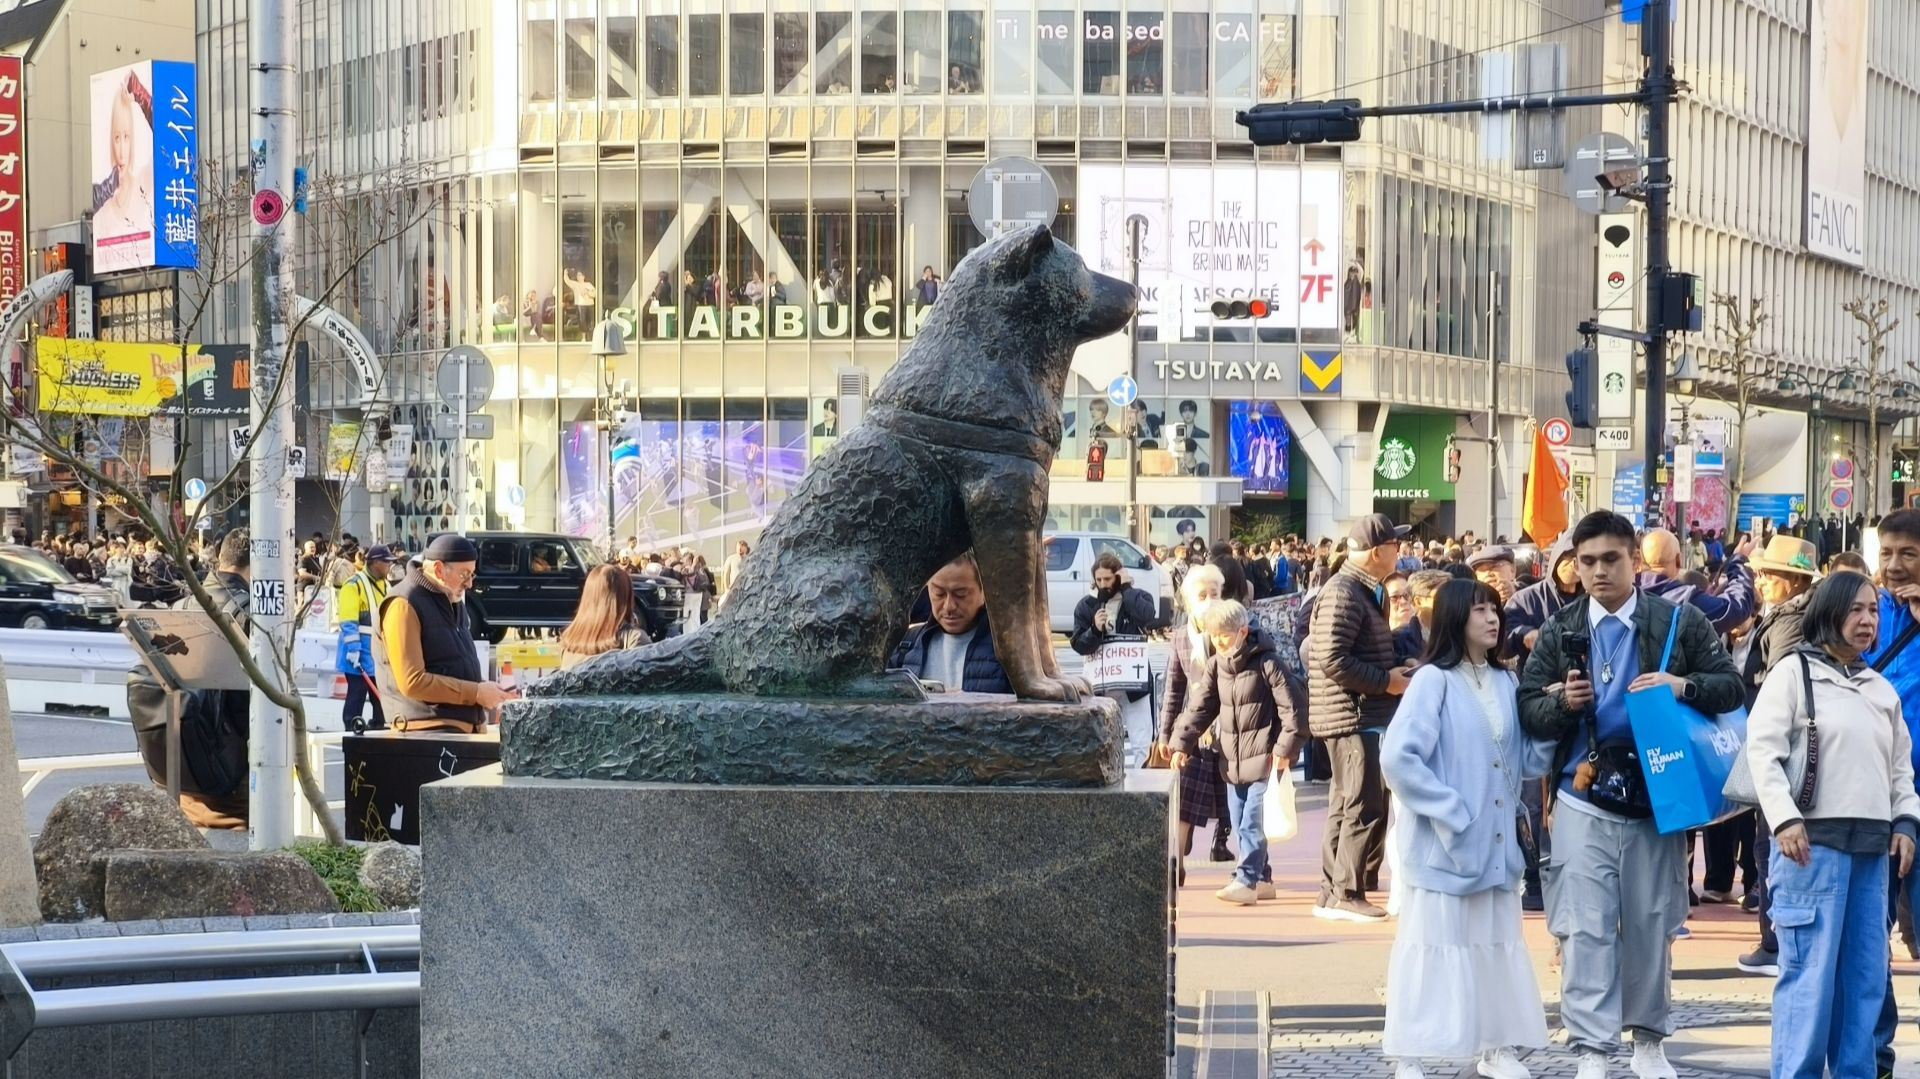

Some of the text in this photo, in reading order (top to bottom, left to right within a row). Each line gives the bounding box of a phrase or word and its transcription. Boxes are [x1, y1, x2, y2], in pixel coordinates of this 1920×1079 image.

[1216, 21, 1286, 42] CAFE
[0, 76, 20, 212] カラオケ
[165, 85, 196, 245] 藍井エイル
[1221, 200, 1243, 219] THE
[1810, 192, 1861, 255] FANCL
[0, 231, 14, 264] BIG
[1300, 274, 1333, 303] 7F
[610, 304, 935, 339] STARBUCK
[328, 320, 374, 388] 渋谷センター街
[1154, 360, 1283, 382] TSUTAYA
[1610, 430, 1629, 441] 400
[1373, 489, 1430, 498] ARBUCKS
[253, 580, 284, 597] OYE
[1105, 646, 1146, 659] CHRIST
[1094, 664, 1122, 679] SAVES
[1646, 747, 1661, 758] FLY
[1648, 750, 1684, 767] HUMAN
[1651, 763, 1666, 775] FLY
